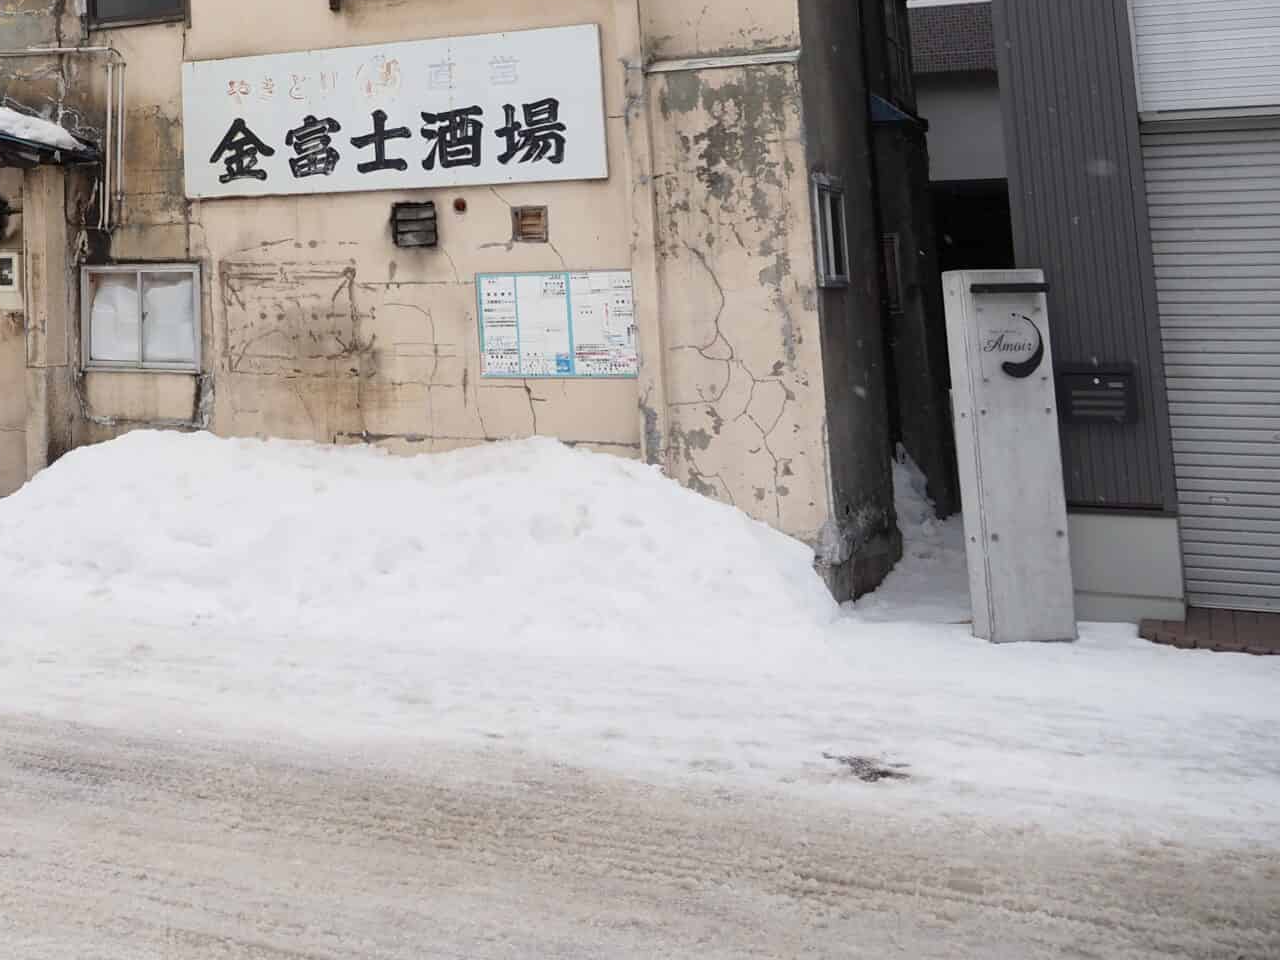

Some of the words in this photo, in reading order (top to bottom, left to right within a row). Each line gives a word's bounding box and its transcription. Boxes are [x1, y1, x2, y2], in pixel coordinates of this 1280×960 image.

[209, 97, 568, 184] 金富士酒場
